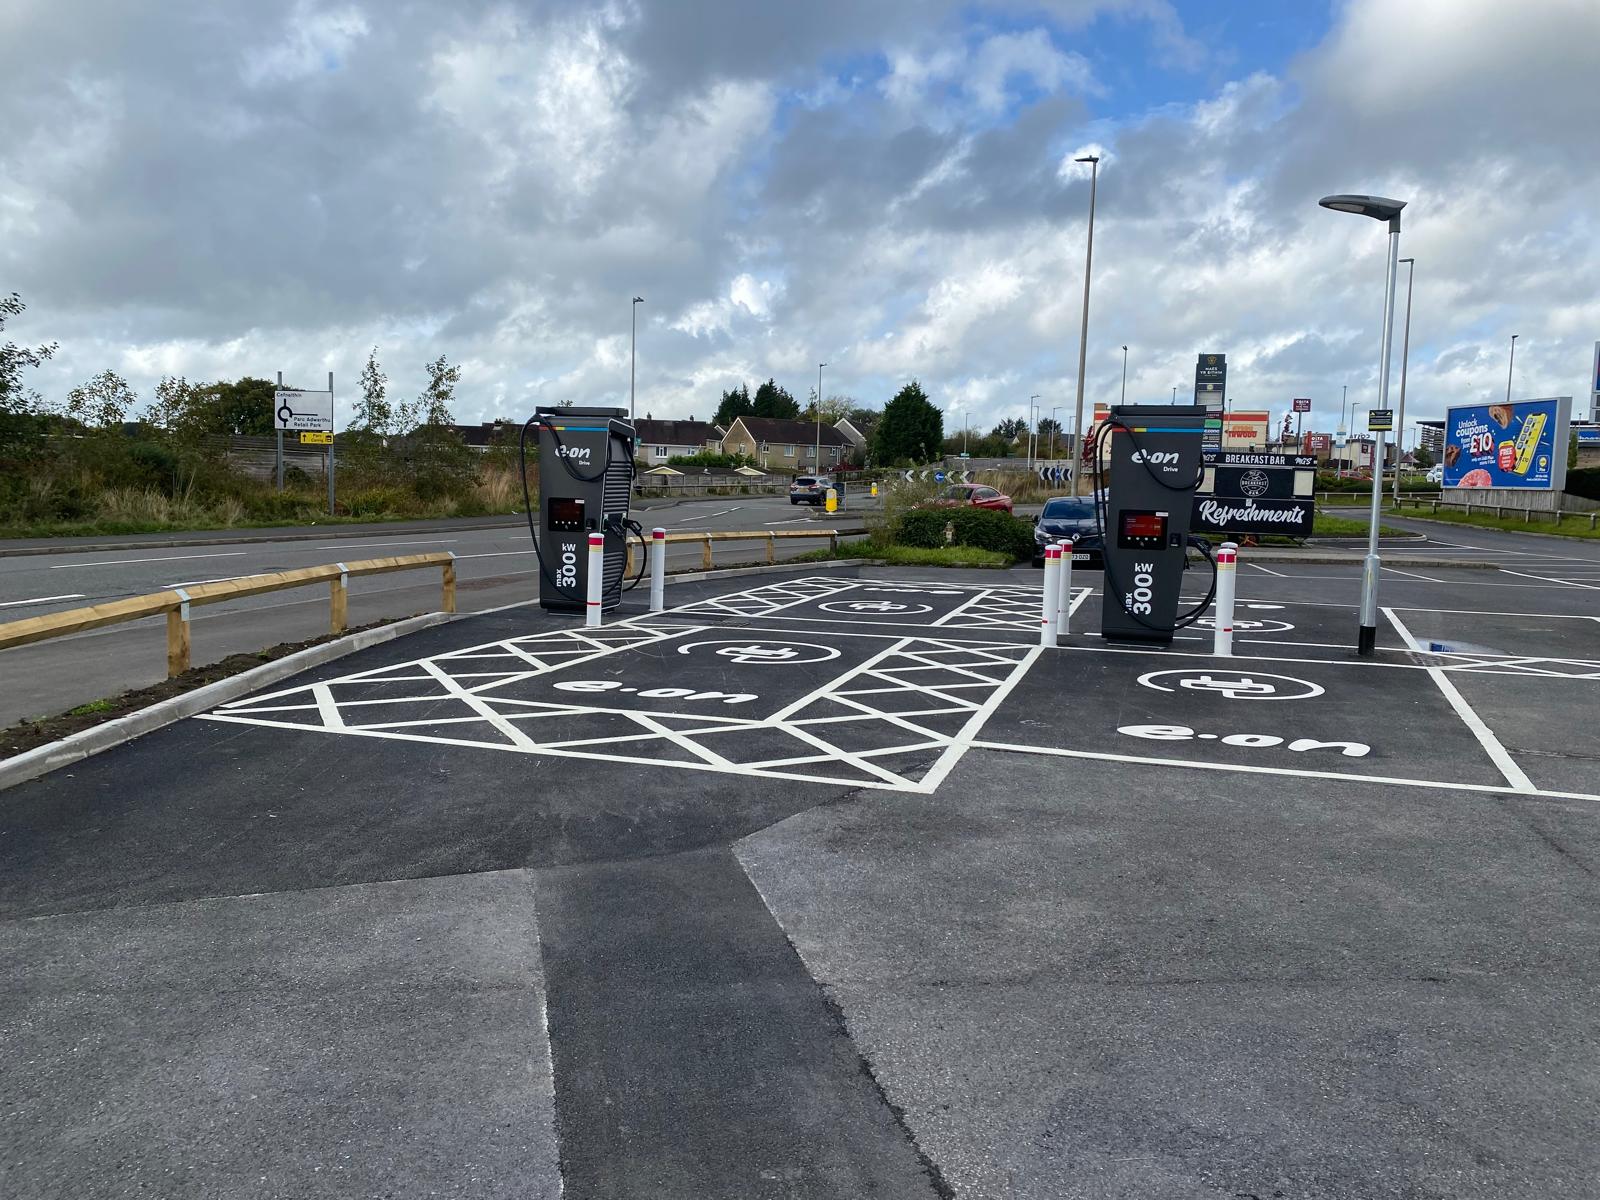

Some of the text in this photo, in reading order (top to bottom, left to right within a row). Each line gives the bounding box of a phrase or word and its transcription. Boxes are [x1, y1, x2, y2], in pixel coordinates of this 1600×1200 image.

[1455, 424, 1488, 438] coupons
[1458, 419, 1478, 429] Unlock
[1469, 432, 1493, 454] £10
[1225, 454, 1269, 464] BREAKFAST
[1269, 456, 1286, 465] BAR
[1199, 499, 1305, 527] Refreshments
[562, 543, 576, 552] kW
[562, 552, 577, 588] 300
[1134, 562, 1154, 573] kW
[1132, 573, 1153, 615] 300
